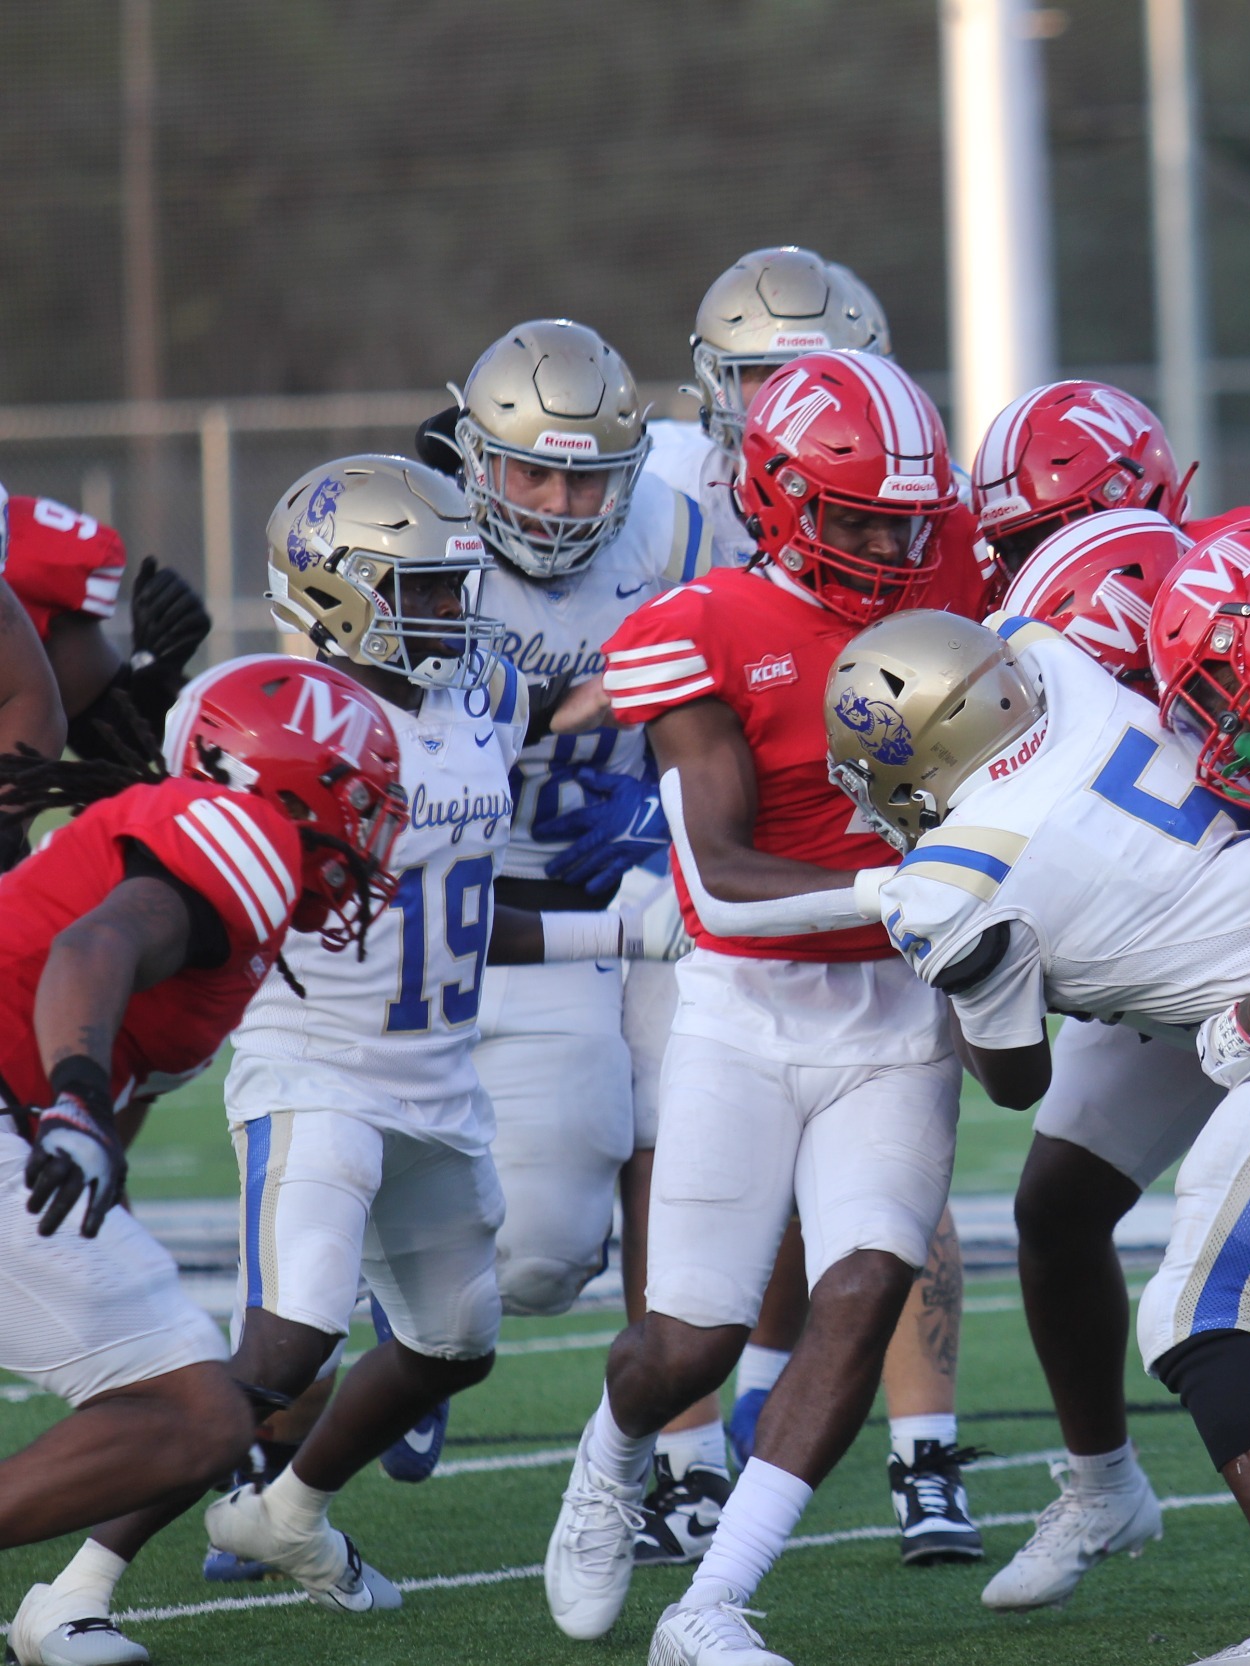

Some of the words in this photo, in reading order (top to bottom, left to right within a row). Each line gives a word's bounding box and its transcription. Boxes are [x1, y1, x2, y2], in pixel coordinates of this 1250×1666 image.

[545, 437, 591, 450] Riddell
[754, 368, 841, 457] M
[1059, 389, 1152, 462] M
[751, 659, 793, 684] KCAC
[282, 674, 381, 770] M
[381, 851, 494, 1036] 19
